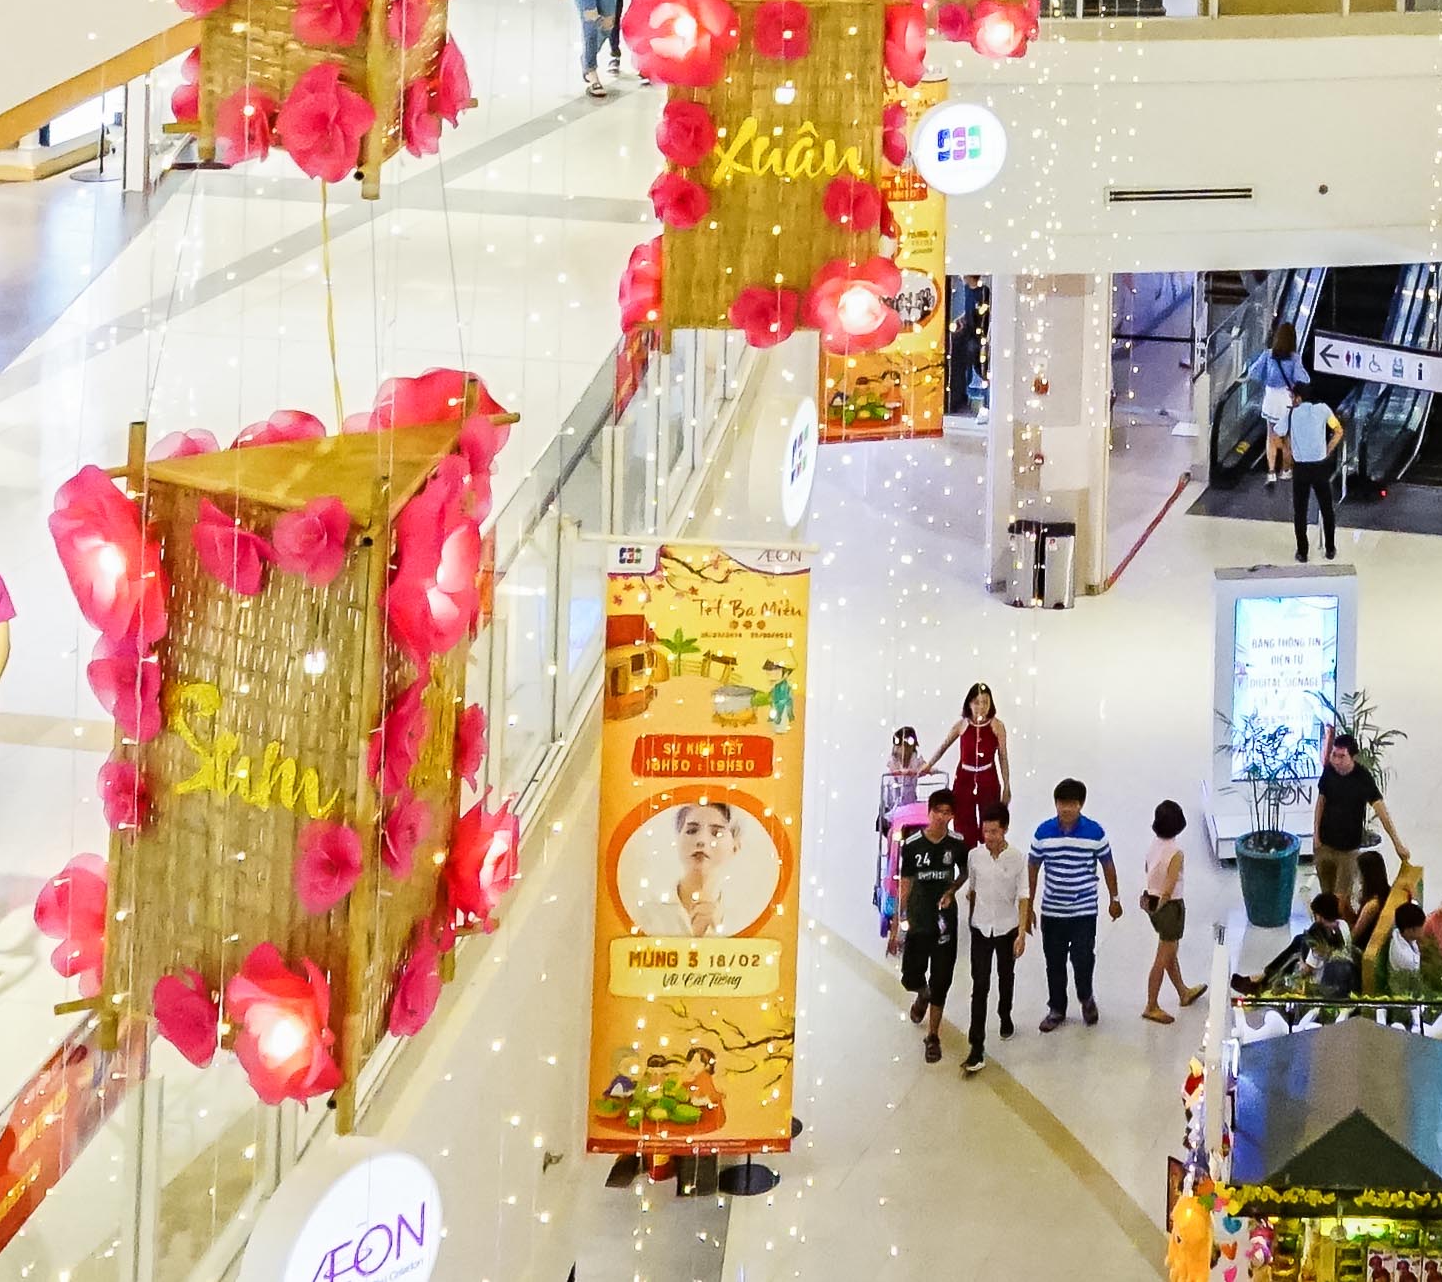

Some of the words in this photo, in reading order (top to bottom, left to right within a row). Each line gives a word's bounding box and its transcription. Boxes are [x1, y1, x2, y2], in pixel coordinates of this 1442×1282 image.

[712, 115, 869, 188] Xuân
[914, 851, 932, 868] 24
[688, 952, 699, 969] 3
[709, 953, 761, 969] 18/02
